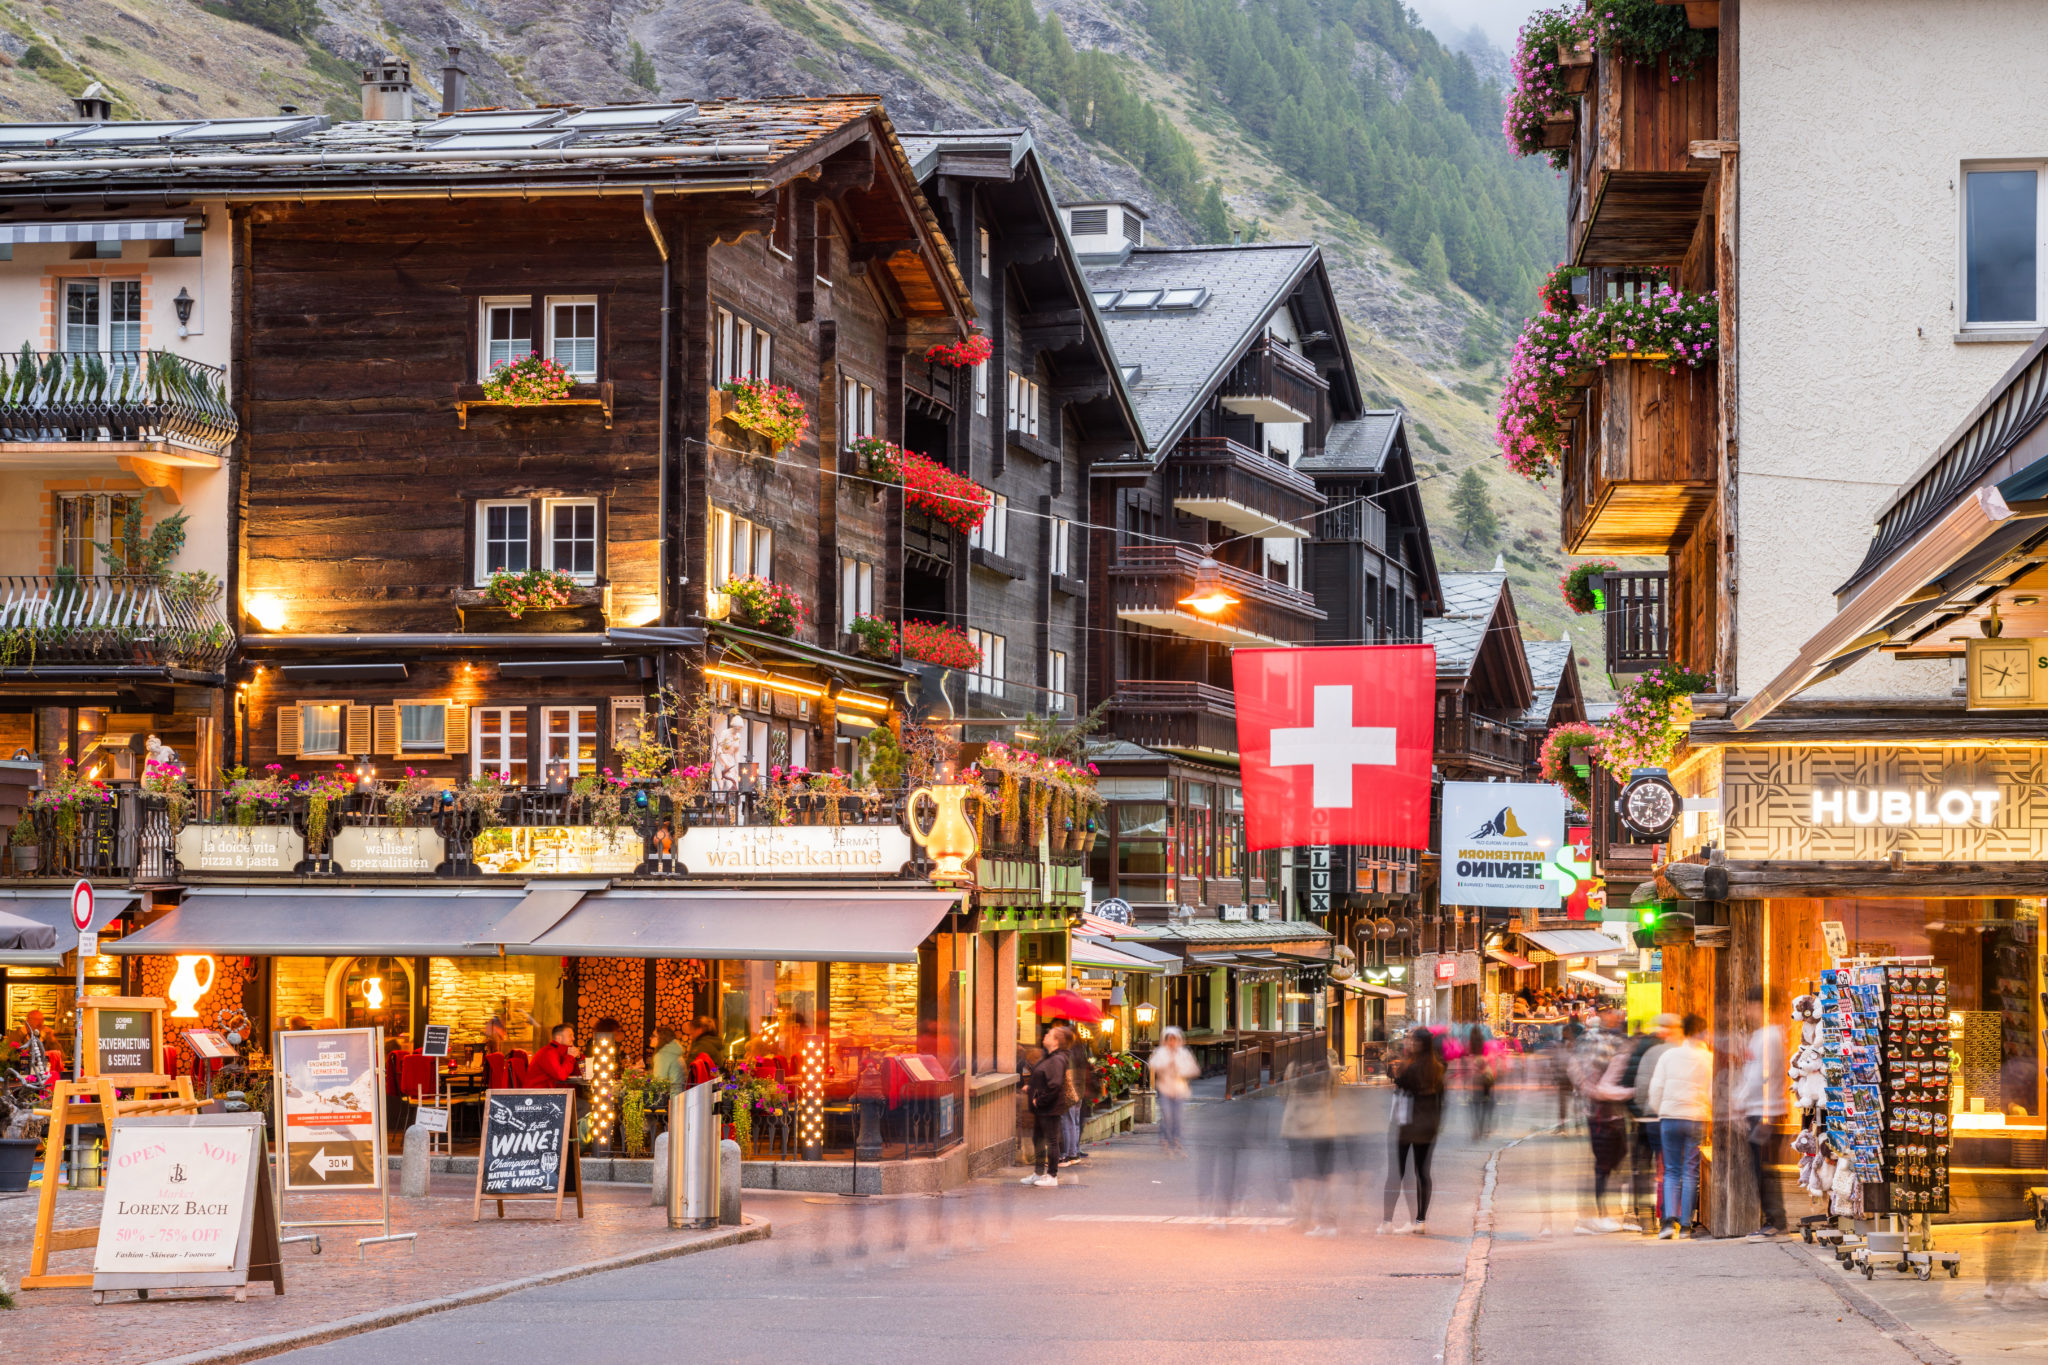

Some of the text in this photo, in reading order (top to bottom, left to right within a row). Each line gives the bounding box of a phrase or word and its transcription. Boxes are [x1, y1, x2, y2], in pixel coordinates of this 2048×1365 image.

[1811, 789, 2001, 824] HUBLOT
[203, 840, 276, 853] la dolce vita
[832, 837, 881, 847] ZERMATT
[365, 843, 414, 855] walliser
[201, 854, 279, 868] pizza & pasta
[705, 845, 882, 867] walliserkanne
[1312, 808, 1329, 911] OLLUX
[98, 1038, 150, 1050] SKIVERMIETUNG
[108, 1054, 142, 1066] & SERVICE
[526, 1120, 550, 1131] Local
[492, 1131, 552, 1157] WINE
[551, 1128, 559, 1150] BAR
[118, 1141, 242, 1168] OPEN NOW
[329, 1159, 348, 1167] 30 M
[489, 1158, 540, 1171] Champagne
[488, 1168, 540, 1180] NATURAL WINES
[486, 1175, 545, 1190] FINE WINES
[117, 1201, 229, 1215] LORENZ BACH
[116, 1228, 145, 1242] 50%
[159, 1228, 188, 1242] 75%
[192, 1228, 223, 1242] OFF
[115, 1251, 144, 1259] Fashion
[149, 1251, 178, 1259] Skiwear
